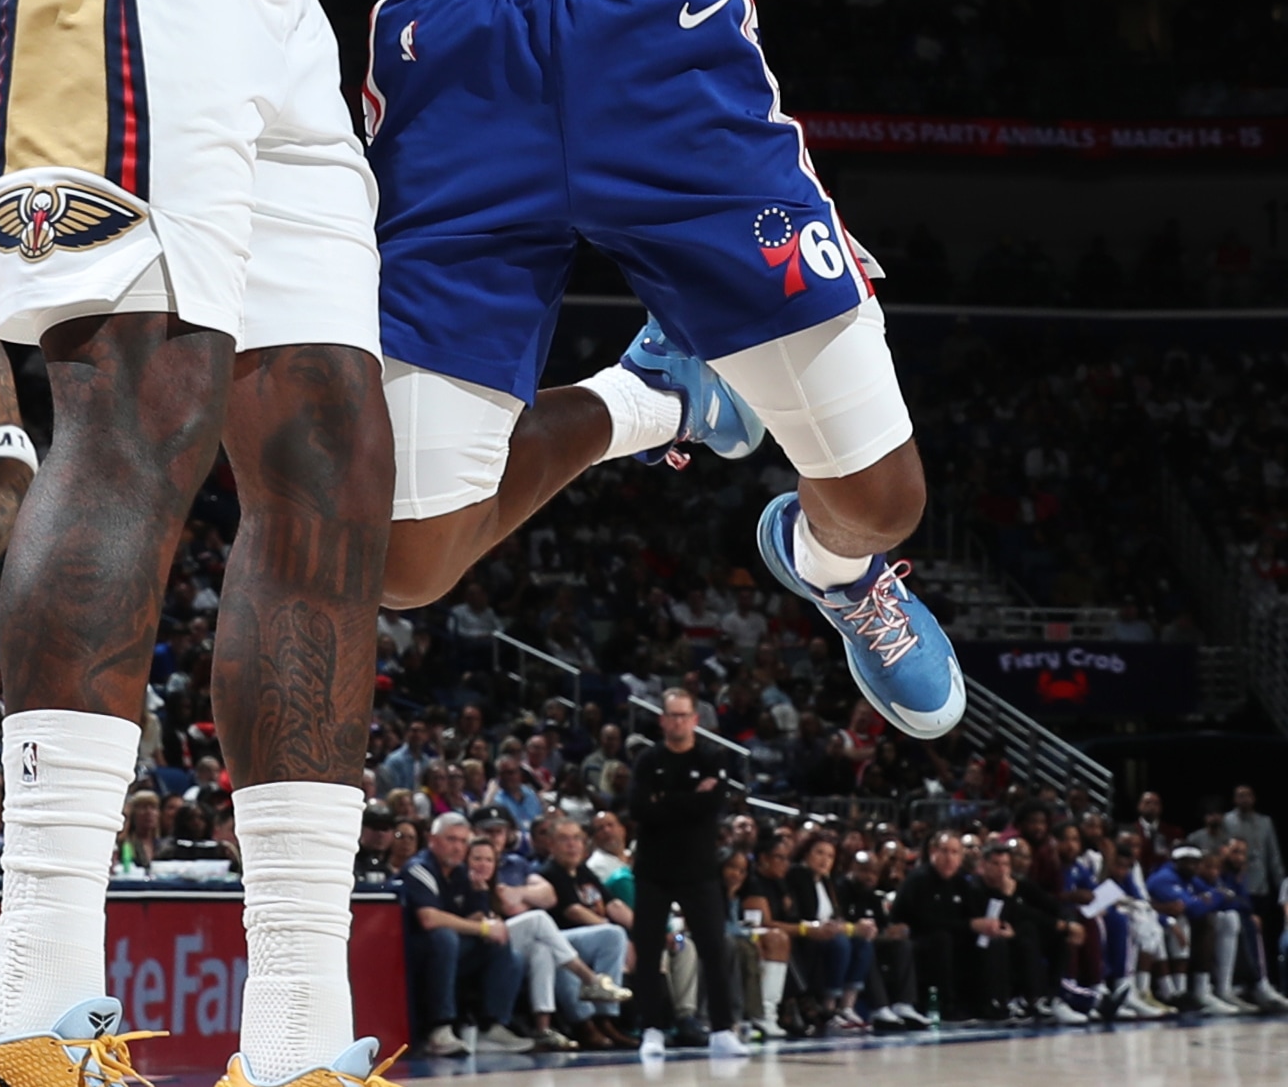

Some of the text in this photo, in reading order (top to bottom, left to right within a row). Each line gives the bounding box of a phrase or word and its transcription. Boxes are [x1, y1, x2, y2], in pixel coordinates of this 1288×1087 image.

[807, 120, 884, 142] NANAS
[886, 121, 917, 143] VS
[919, 122, 991, 144] PARTY
[995, 126, 1097, 148] ANIMALS
[1111, 127, 1195, 149] MARCH
[1198, 128, 1223, 148] 14
[1239, 126, 1264, 149] 15
[755, 220, 845, 298] 76
[999, 647, 1127, 674] Fiery Crab
